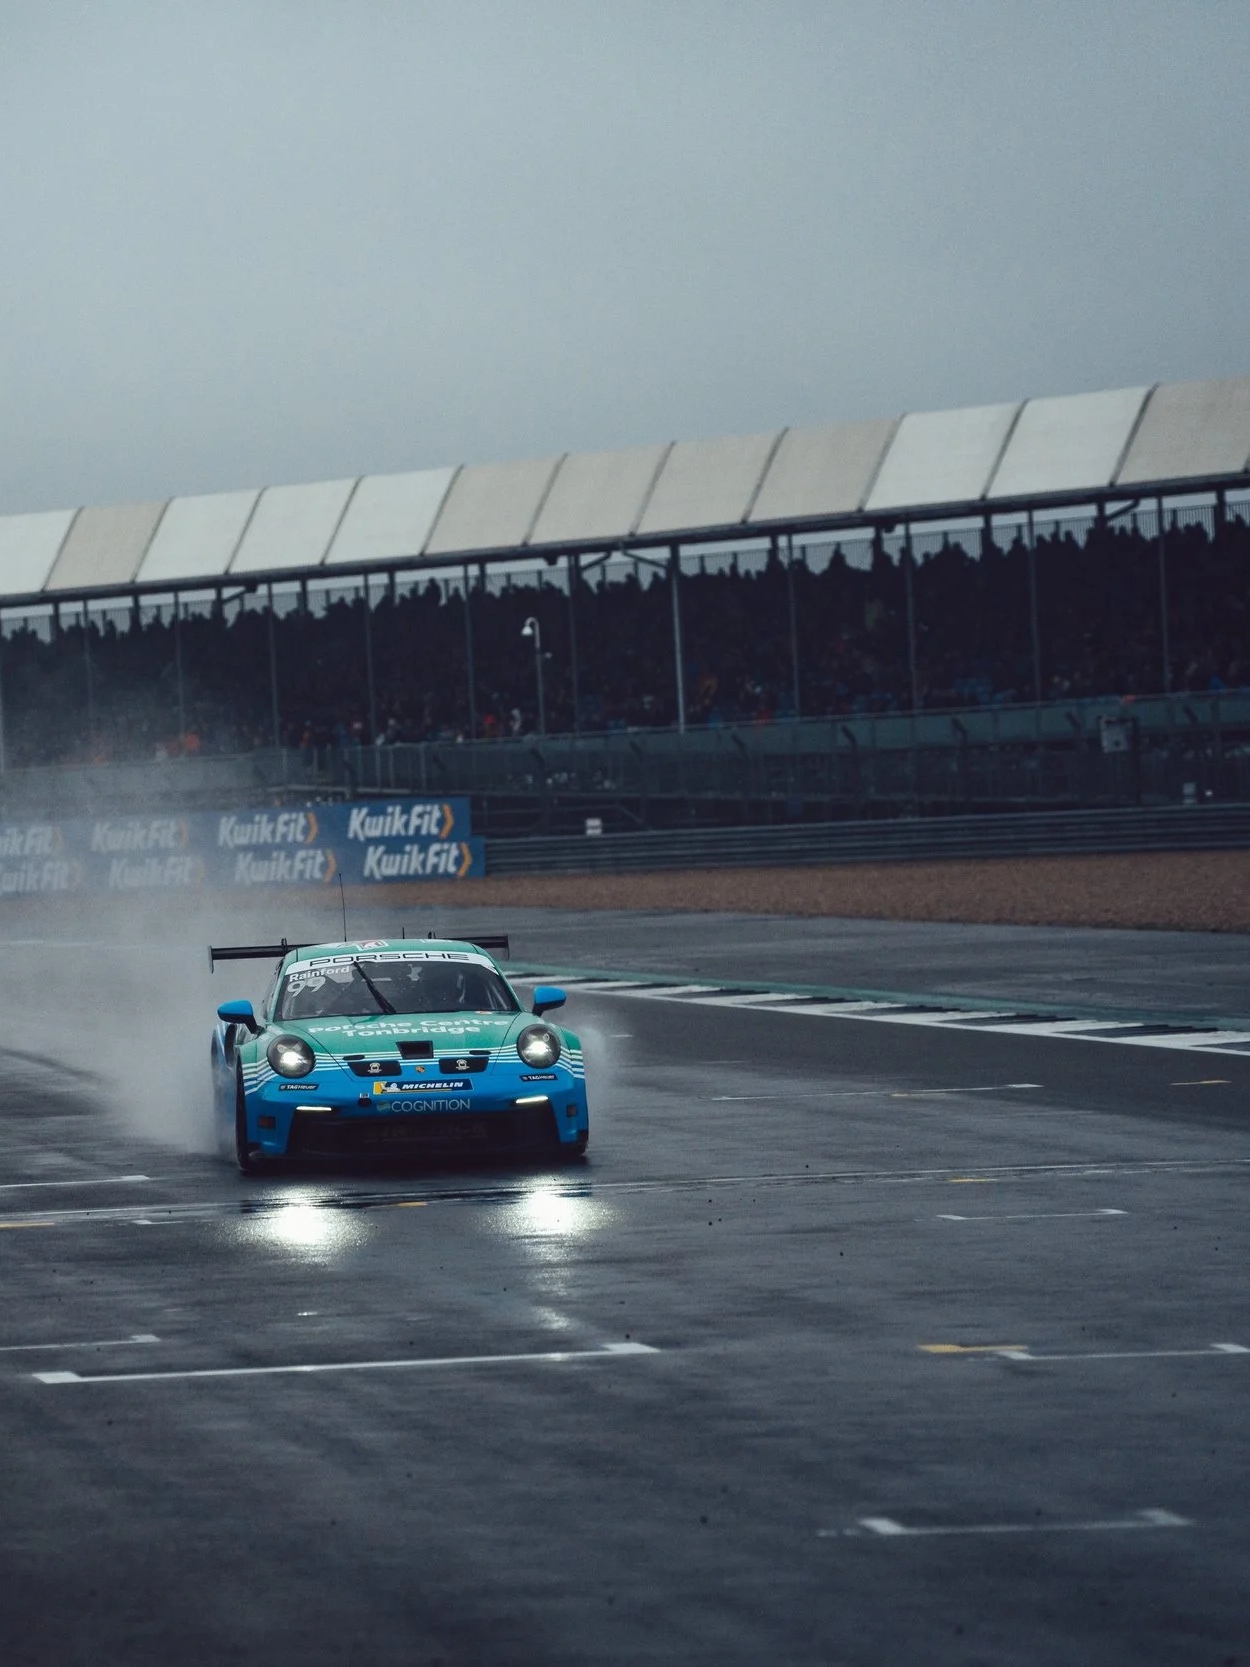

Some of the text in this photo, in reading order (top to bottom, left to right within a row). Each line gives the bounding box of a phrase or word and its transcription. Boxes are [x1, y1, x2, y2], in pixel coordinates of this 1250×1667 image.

[310, 952, 470, 968] PORSCHE
[289, 966, 350, 982] Rainford
[287, 976, 327, 998] 99
[308, 1018, 510, 1034] Porsche Centre
[342, 1025, 481, 1037] Tonbridge
[402, 1082, 464, 1090] MICHELIN
[390, 1098, 471, 1113] COGNITION
